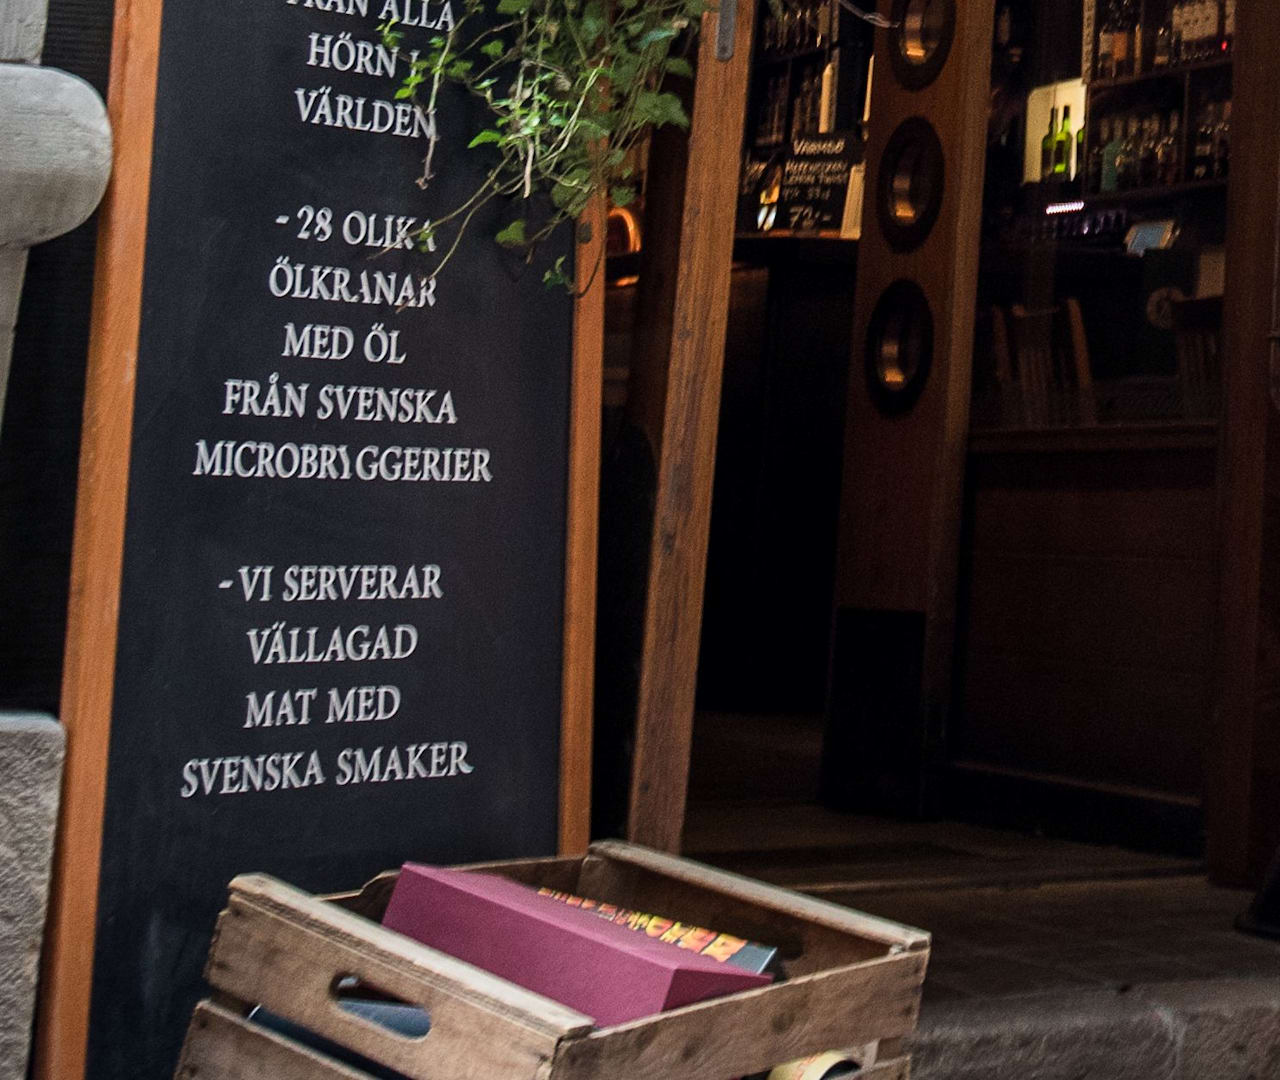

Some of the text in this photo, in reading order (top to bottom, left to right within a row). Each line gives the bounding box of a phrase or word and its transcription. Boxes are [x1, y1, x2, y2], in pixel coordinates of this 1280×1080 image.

[307, 30, 400, 78] HÖRN
[294, 86, 439, 140] VÄRLDEN
[281, 323, 407, 365] MED ÖL
[221, 371, 458, 425] FRÅN SVENSKA
[192, 440, 493, 483] MICROBRYGGERIER
[282, 564, 444, 602] SERVERAR
[246, 622, 419, 665] VÄLLAGAD
[242, 685, 401, 729] MAT MED
[180, 741, 475, 799] SVENSKA SMAKER
